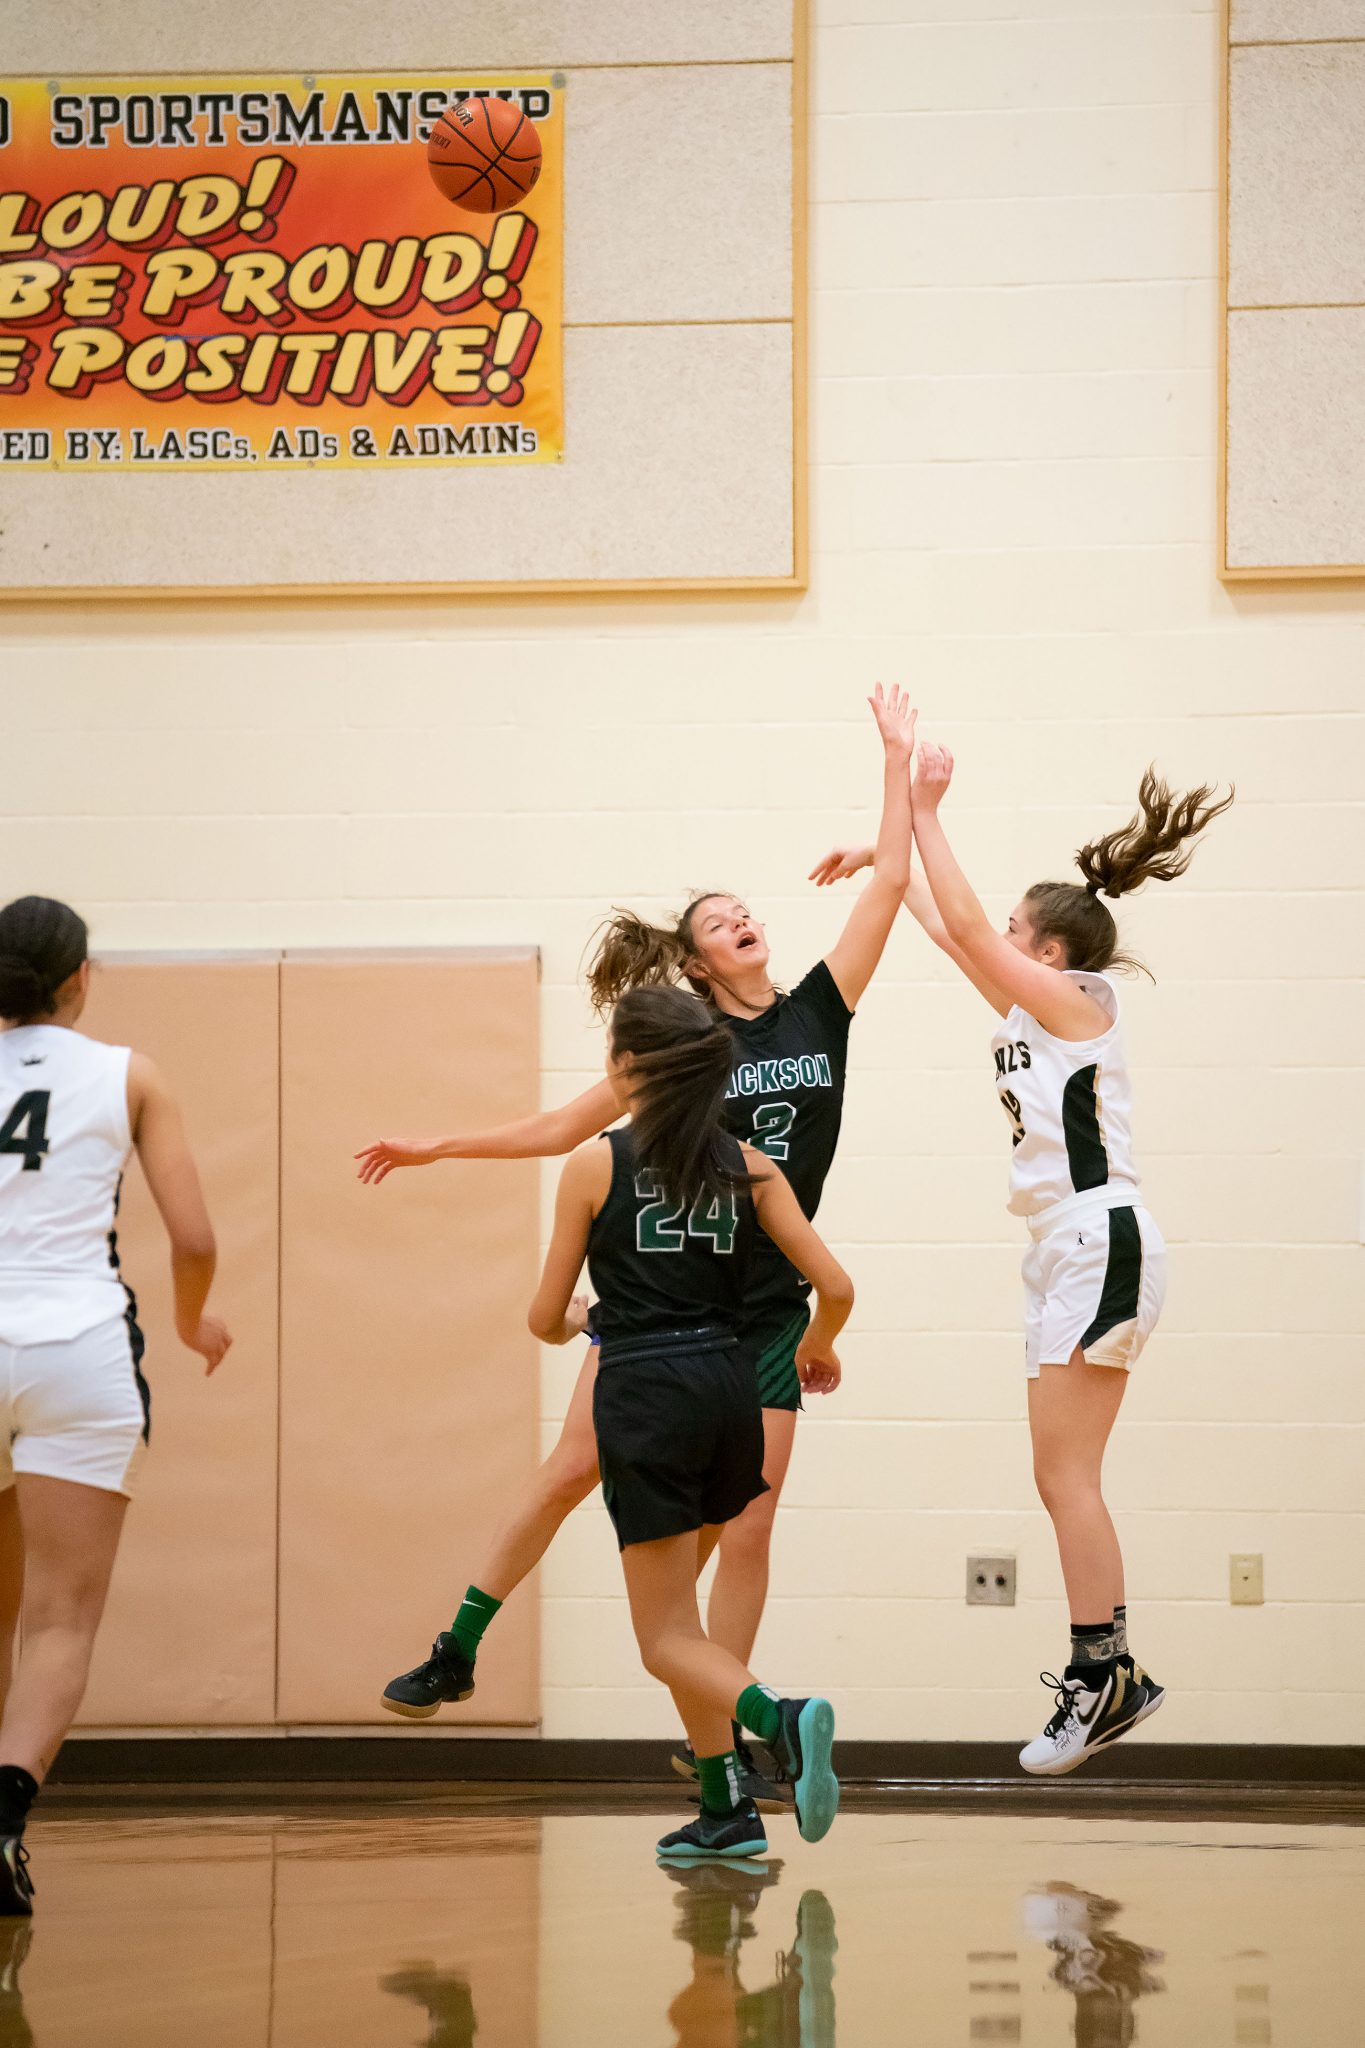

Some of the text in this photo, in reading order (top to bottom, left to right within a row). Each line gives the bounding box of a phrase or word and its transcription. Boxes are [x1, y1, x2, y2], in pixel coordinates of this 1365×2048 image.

[51, 88, 552, 148] SPORTSMANSP
[0, 154, 297, 258] LOUD!
[141, 211, 538, 328] PROUD!
[46, 309, 542, 407] POSITIVE!
[66, 431, 121, 460] BY:
[351, 428, 377, 457] &
[747, 1102, 797, 1160] 2
[635, 1167, 739, 1254] 24
